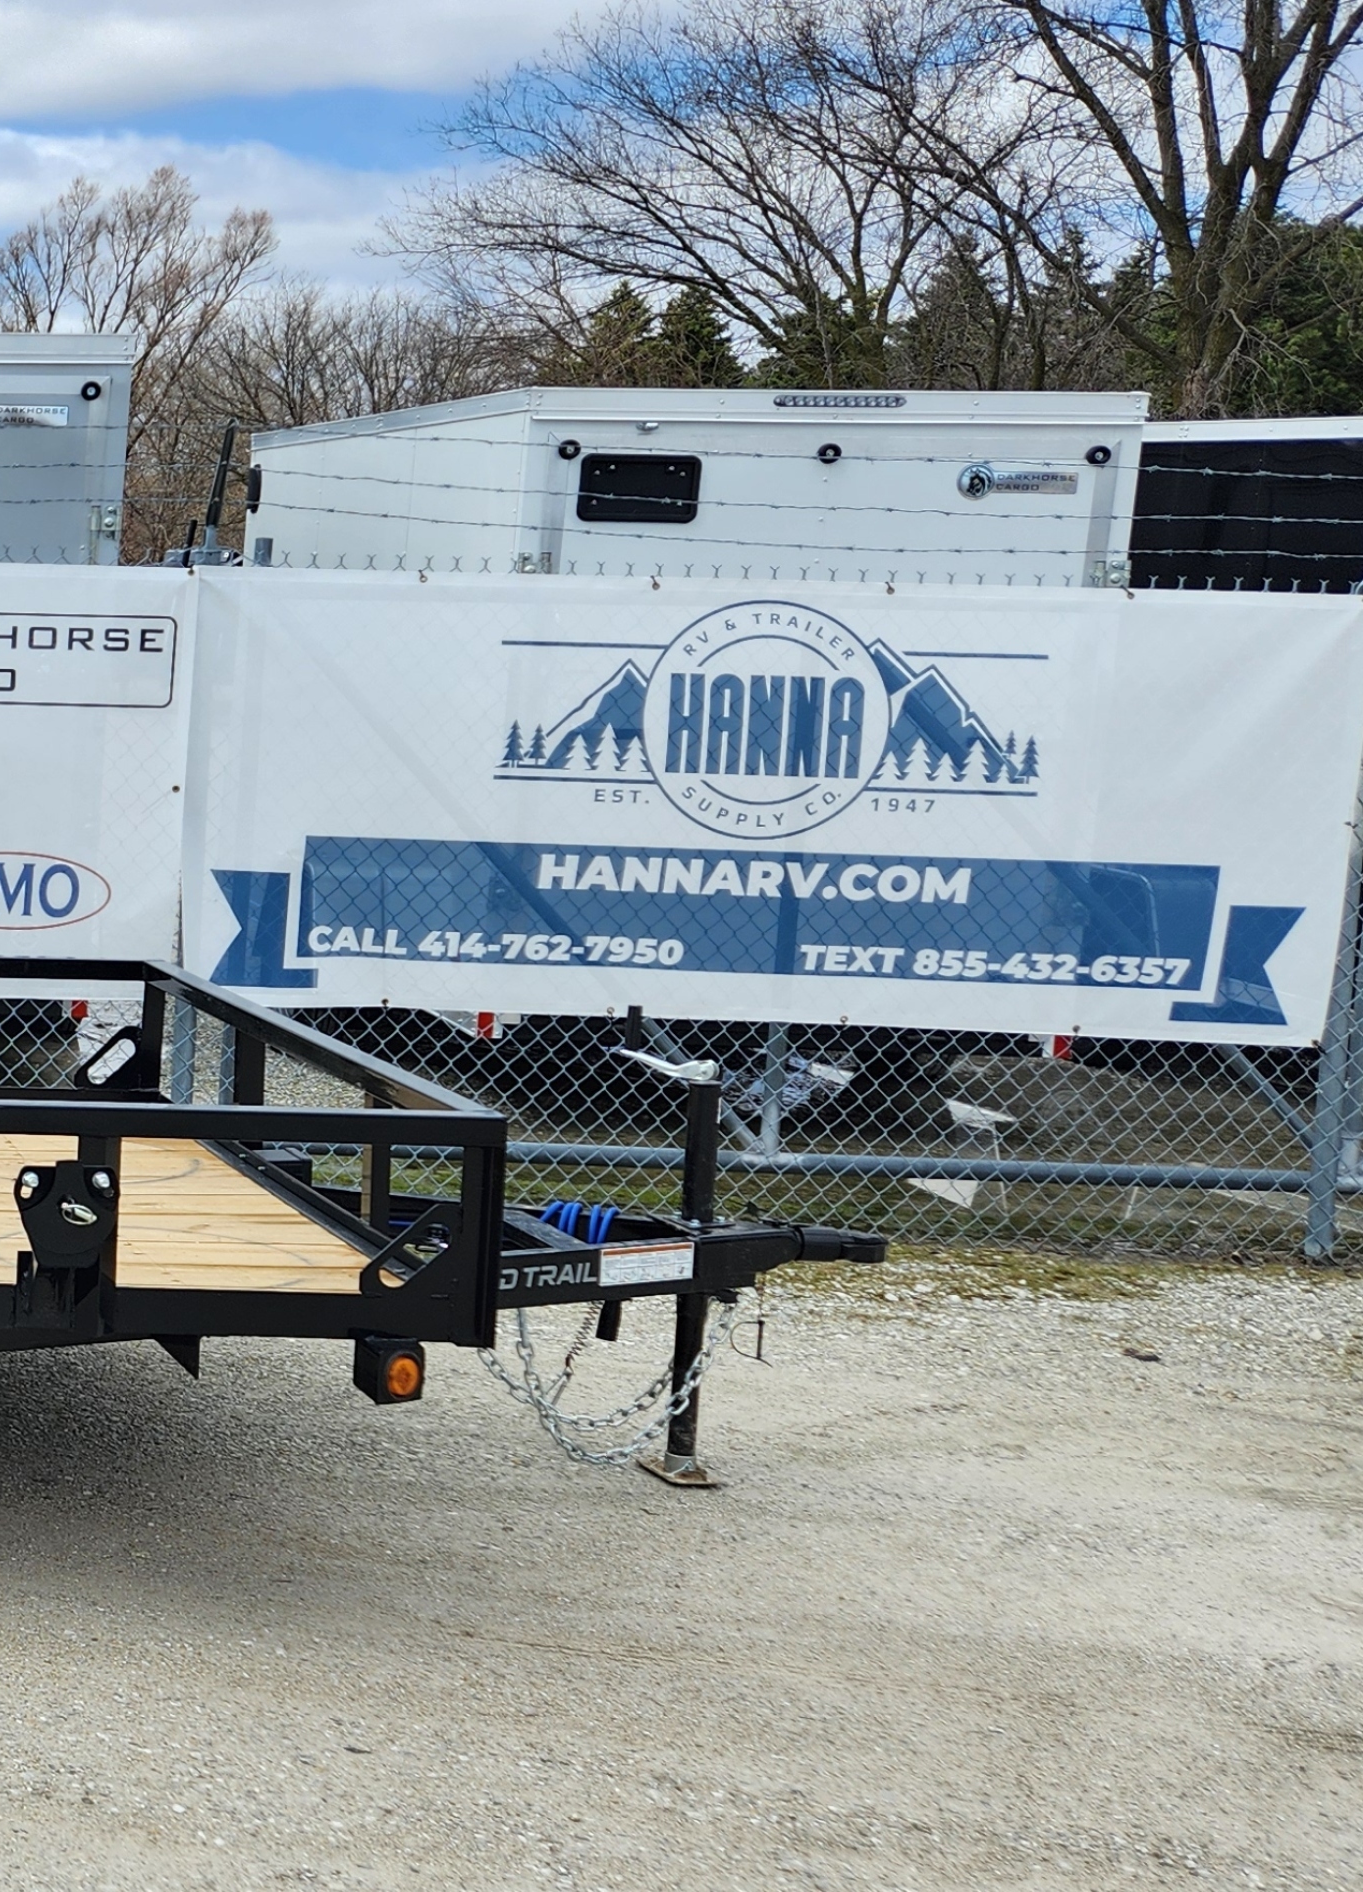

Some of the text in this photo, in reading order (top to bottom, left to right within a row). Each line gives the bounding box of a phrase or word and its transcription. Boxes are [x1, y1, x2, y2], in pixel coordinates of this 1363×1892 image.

[995, 483, 1040, 491] CARGO
[996, 474, 1076, 482] DARKHORSE
[682, 613, 856, 662] RV & TRAILER
[665, 673, 865, 779] HANNA
[594, 787, 937, 829] EST. SUPPLY CO. 1947
[537, 853, 972, 906] HANNARV.COM
[307, 925, 684, 967] CALL 414-762-7950
[800, 943, 1189, 986] TEXT 855-432-6357
[523, 1262, 598, 1288] TRAIL
